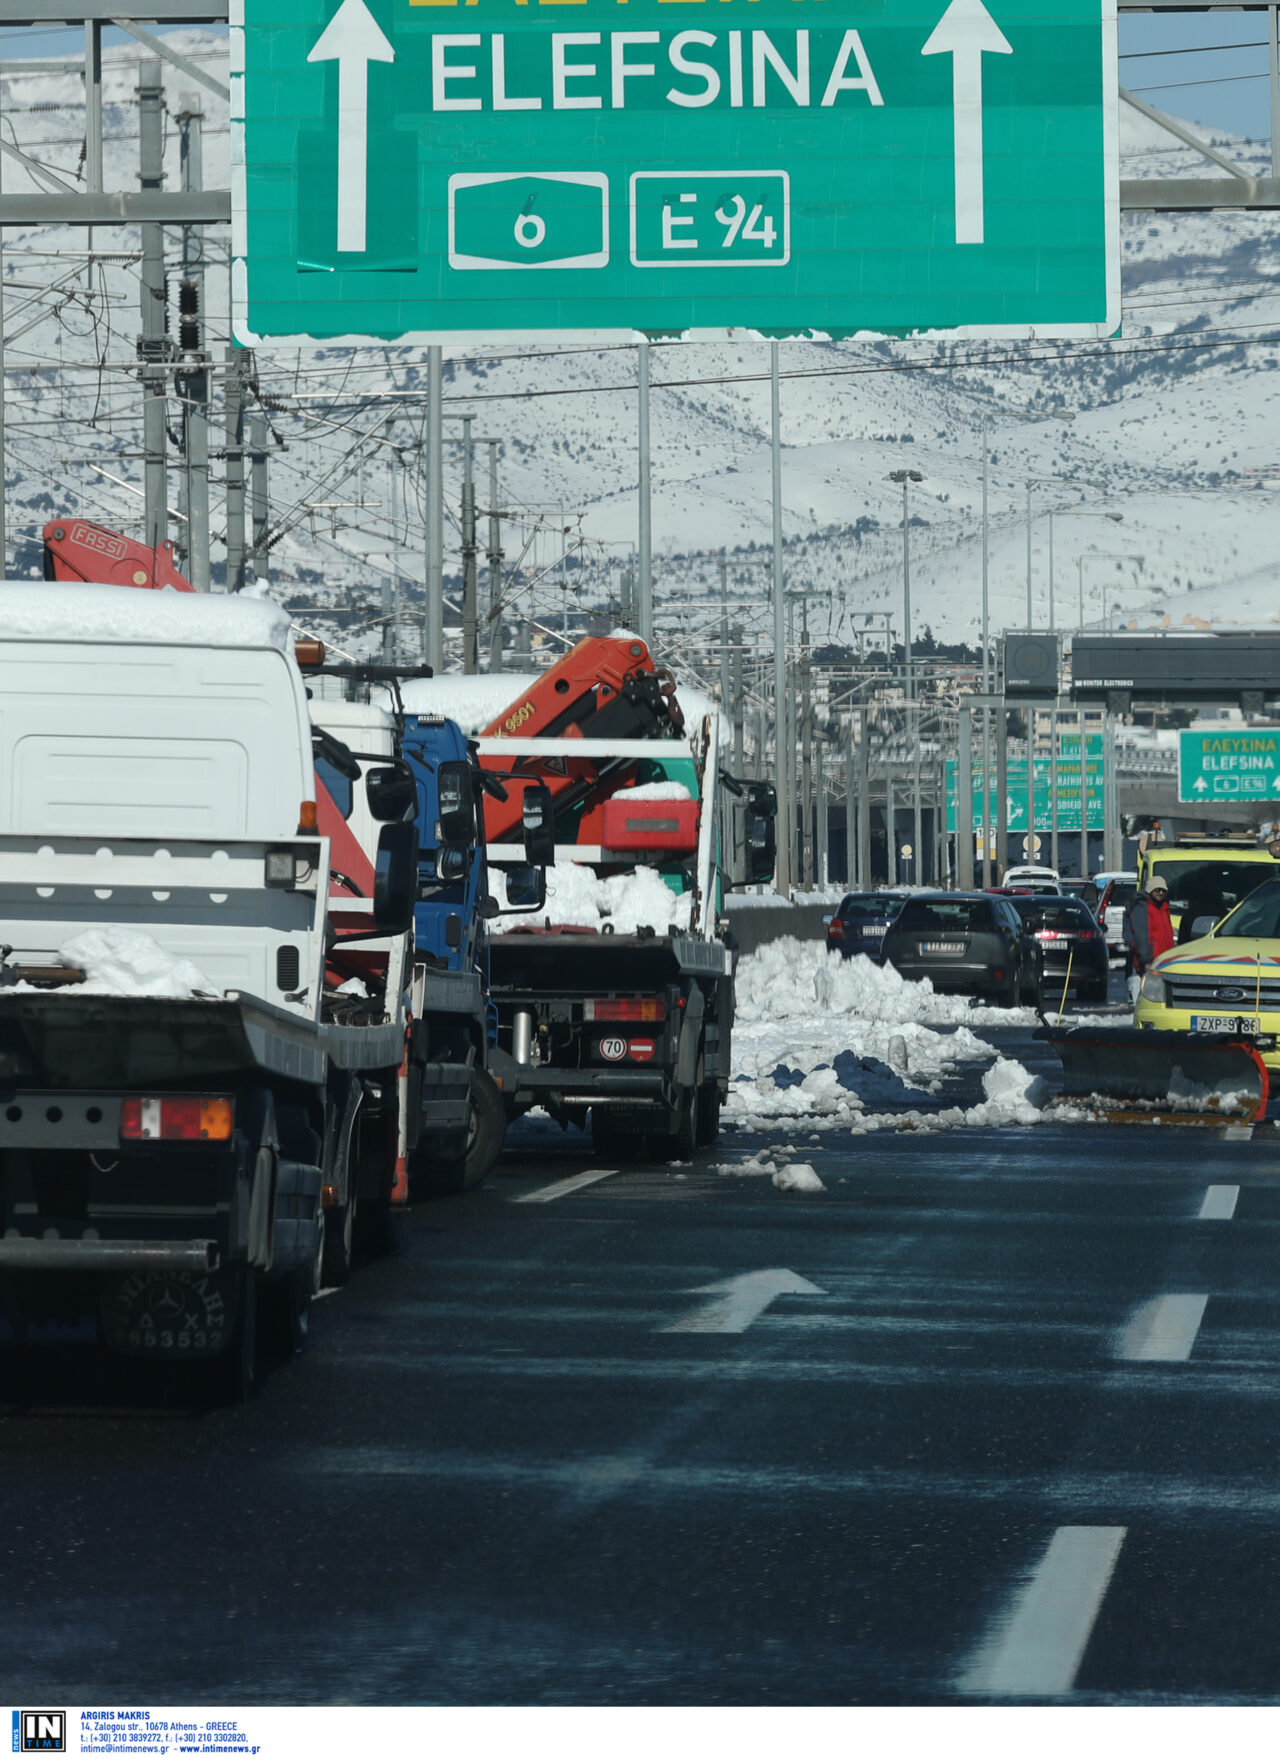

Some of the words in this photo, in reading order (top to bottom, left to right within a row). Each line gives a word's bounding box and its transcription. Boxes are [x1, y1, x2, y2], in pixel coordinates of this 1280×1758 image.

[432, 30, 885, 112] ELEFSINA
[514, 195, 546, 249] 6
[76, 528, 123, 555] FASSI
[505, 702, 535, 732] 9501
[1202, 739, 1277, 753] ΕΛΕΥΣΙΝΑ
[1202, 755, 1275, 771] ELEFSINA
[606, 1041, 621, 1054] 70
